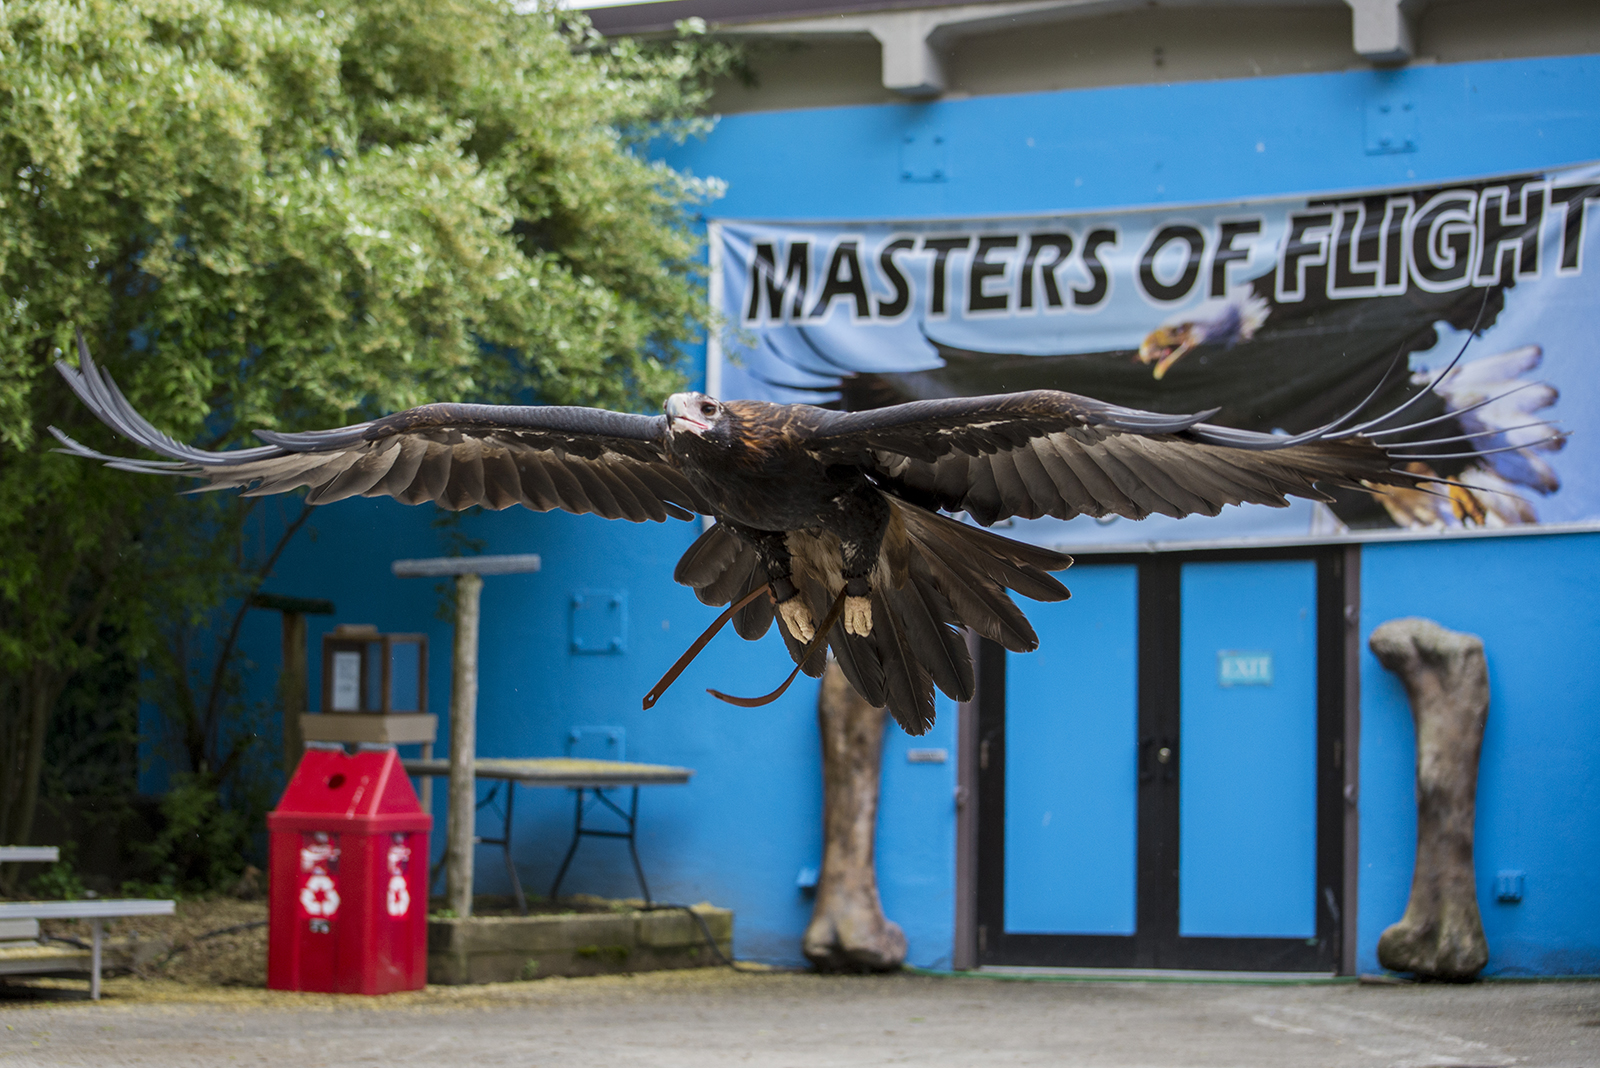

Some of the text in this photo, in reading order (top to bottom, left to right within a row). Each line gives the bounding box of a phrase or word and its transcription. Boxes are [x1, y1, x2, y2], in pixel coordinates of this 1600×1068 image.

[744, 179, 1600, 325] MASTERS OF FLIGHT
[1221, 656, 1269, 679] EXIT
